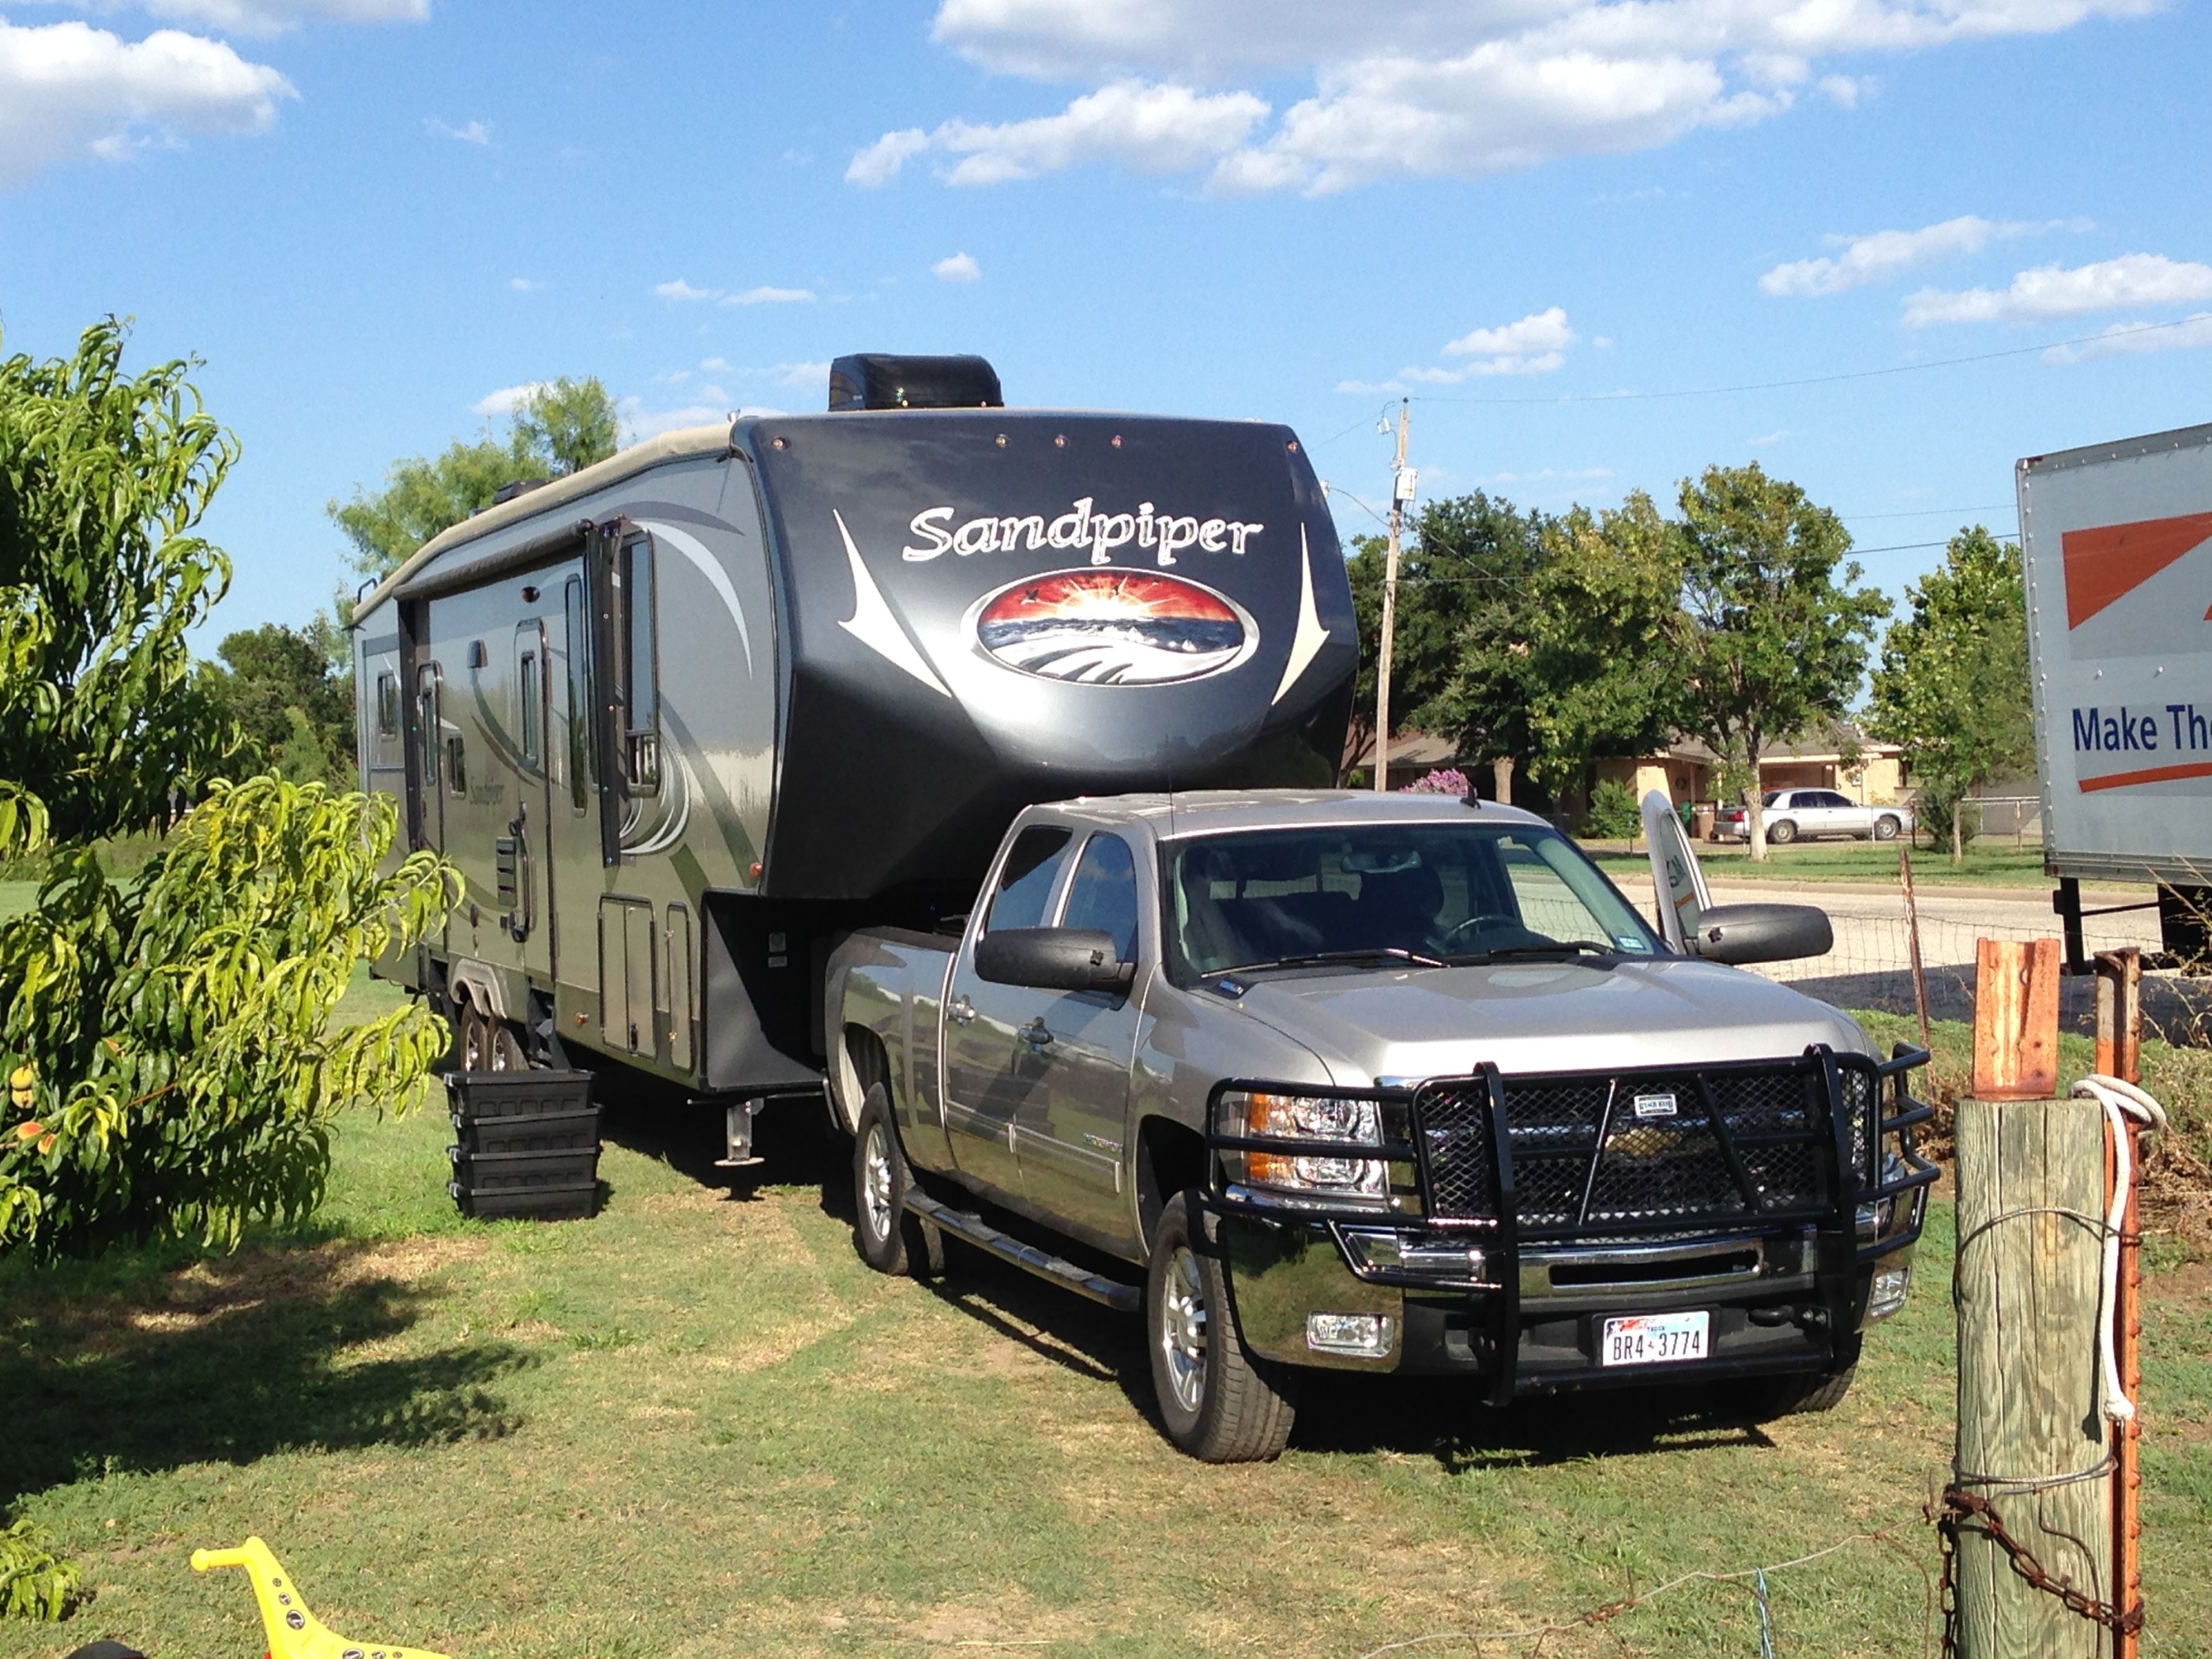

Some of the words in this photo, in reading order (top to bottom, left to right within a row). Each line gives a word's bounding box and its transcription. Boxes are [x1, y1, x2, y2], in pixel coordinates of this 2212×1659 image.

[902, 496, 1264, 566] Sandpiper
[2073, 706, 2157, 751] Make
[2166, 704, 2212, 750] Th
[1613, 1335, 1643, 1360] BR4
[1658, 1330, 1700, 1356] 3774
